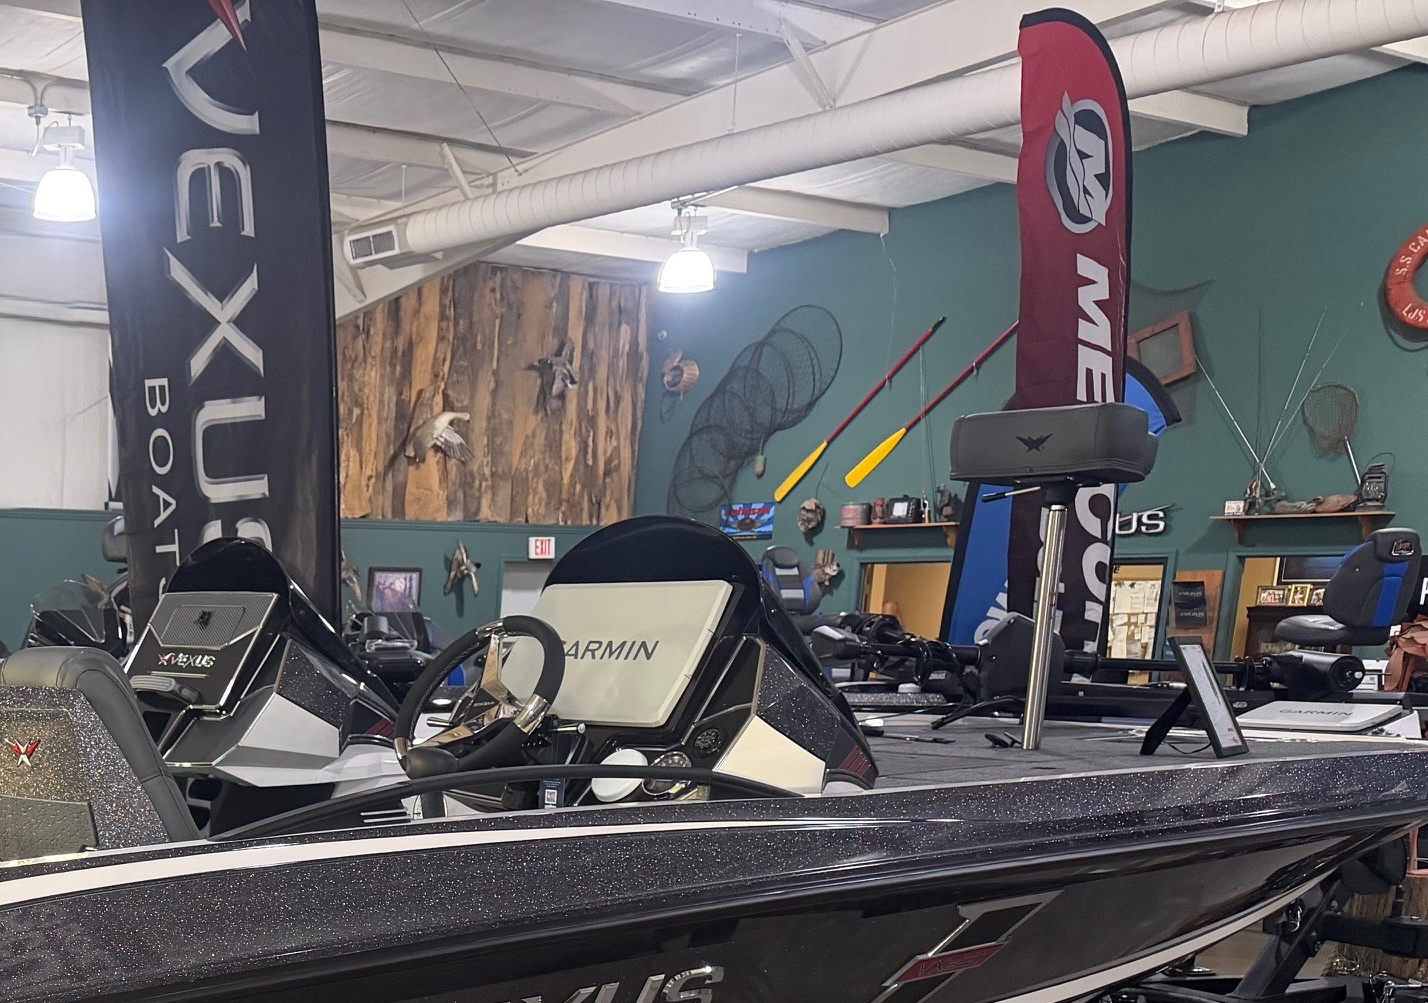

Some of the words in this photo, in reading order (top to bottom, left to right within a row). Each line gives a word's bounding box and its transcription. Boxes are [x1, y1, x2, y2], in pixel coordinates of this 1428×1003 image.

[144, 377, 184, 598] BOAT
[535, 539, 551, 556] EXIT
[561, 640, 660, 661] ARMIN
[170, 652, 216, 669] VEXUS
